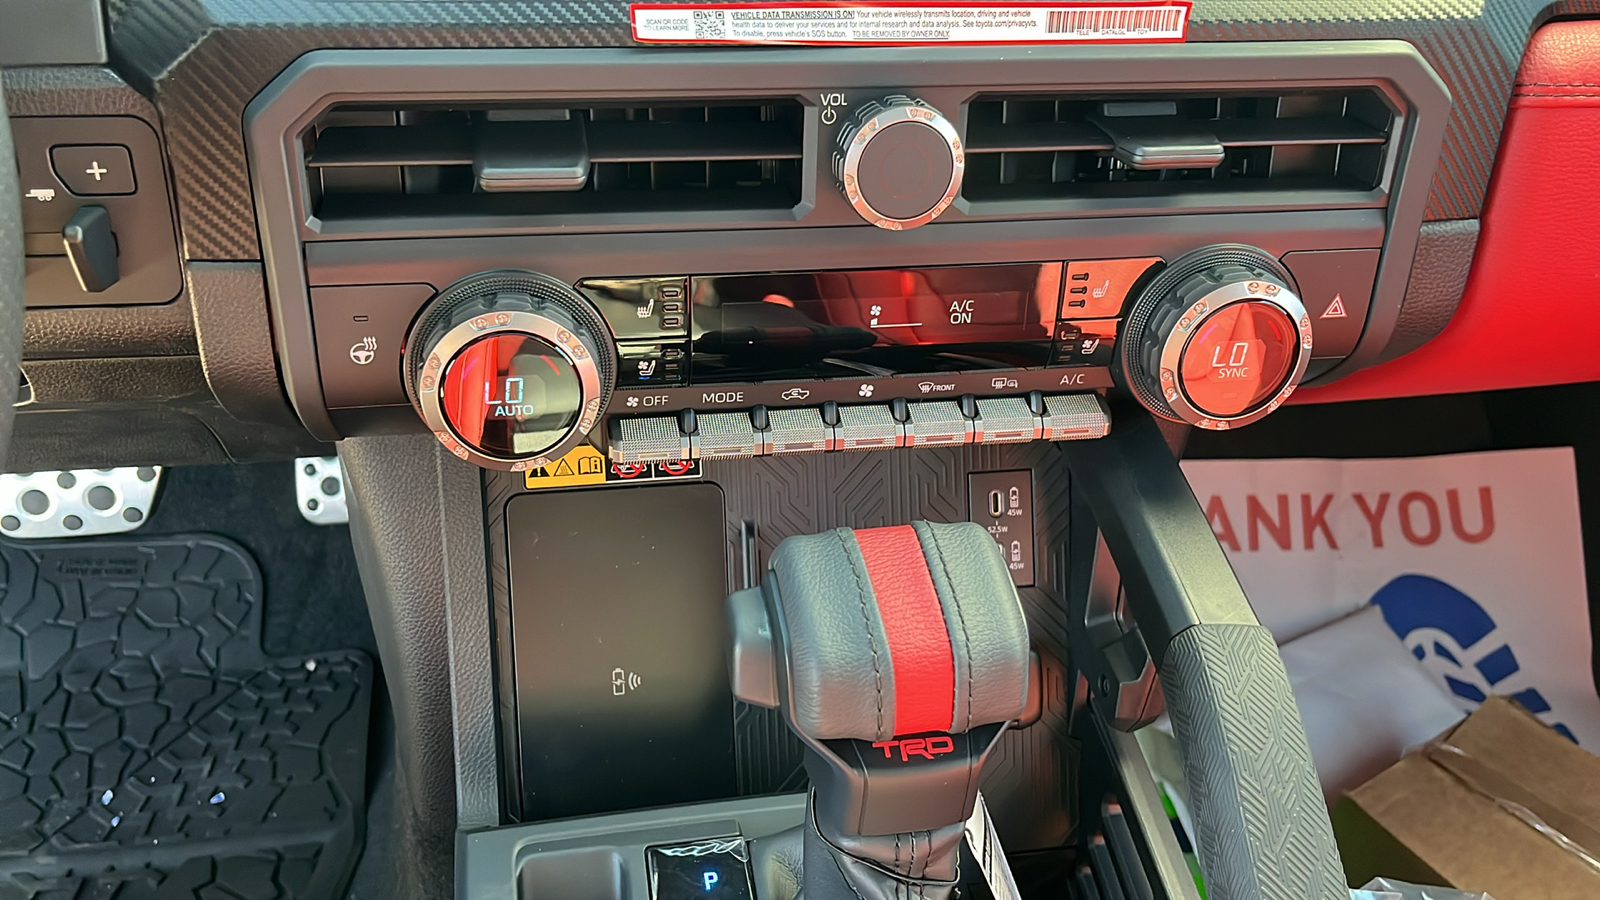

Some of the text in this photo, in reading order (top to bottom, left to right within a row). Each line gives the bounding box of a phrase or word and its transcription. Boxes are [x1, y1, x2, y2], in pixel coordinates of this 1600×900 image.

[731, 10, 1031, 20] VEHICLE DATA TRANSMISSION IS ON! Your vehicle wirelessly transmits location, driving and vehicle
[796, 22, 809, 30] your
[849, 20, 858, 28] for
[859, 20, 881, 28] internal
[882, 20, 908, 28] research
[909, 20, 920, 28] and
[922, 20, 934, 28] data
[936, 20, 961, 29] analysis.
[962, 20, 974, 28] See
[820, 93, 848, 106] VOL
[949, 299, 975, 313] A/C
[950, 312, 972, 325] ON
[1212, 342, 1249, 367] LO
[1060, 373, 1085, 386] A/C
[1218, 367, 1249, 379] SYNC
[485, 377, 524, 405] LO
[933, 383, 956, 392] FRONT
[643, 395, 669, 407] OFF
[702, 391, 744, 404] MODE
[494, 404, 534, 417] AUTO
[1007, 508, 1023, 516] 45W
[1205, 485, 1496, 552] ANK YOU
[987, 525, 1008, 533] 52.5W
[1009, 562, 1024, 570] 45W
[872, 736, 954, 762] TRD
[703, 871, 718, 891] P
